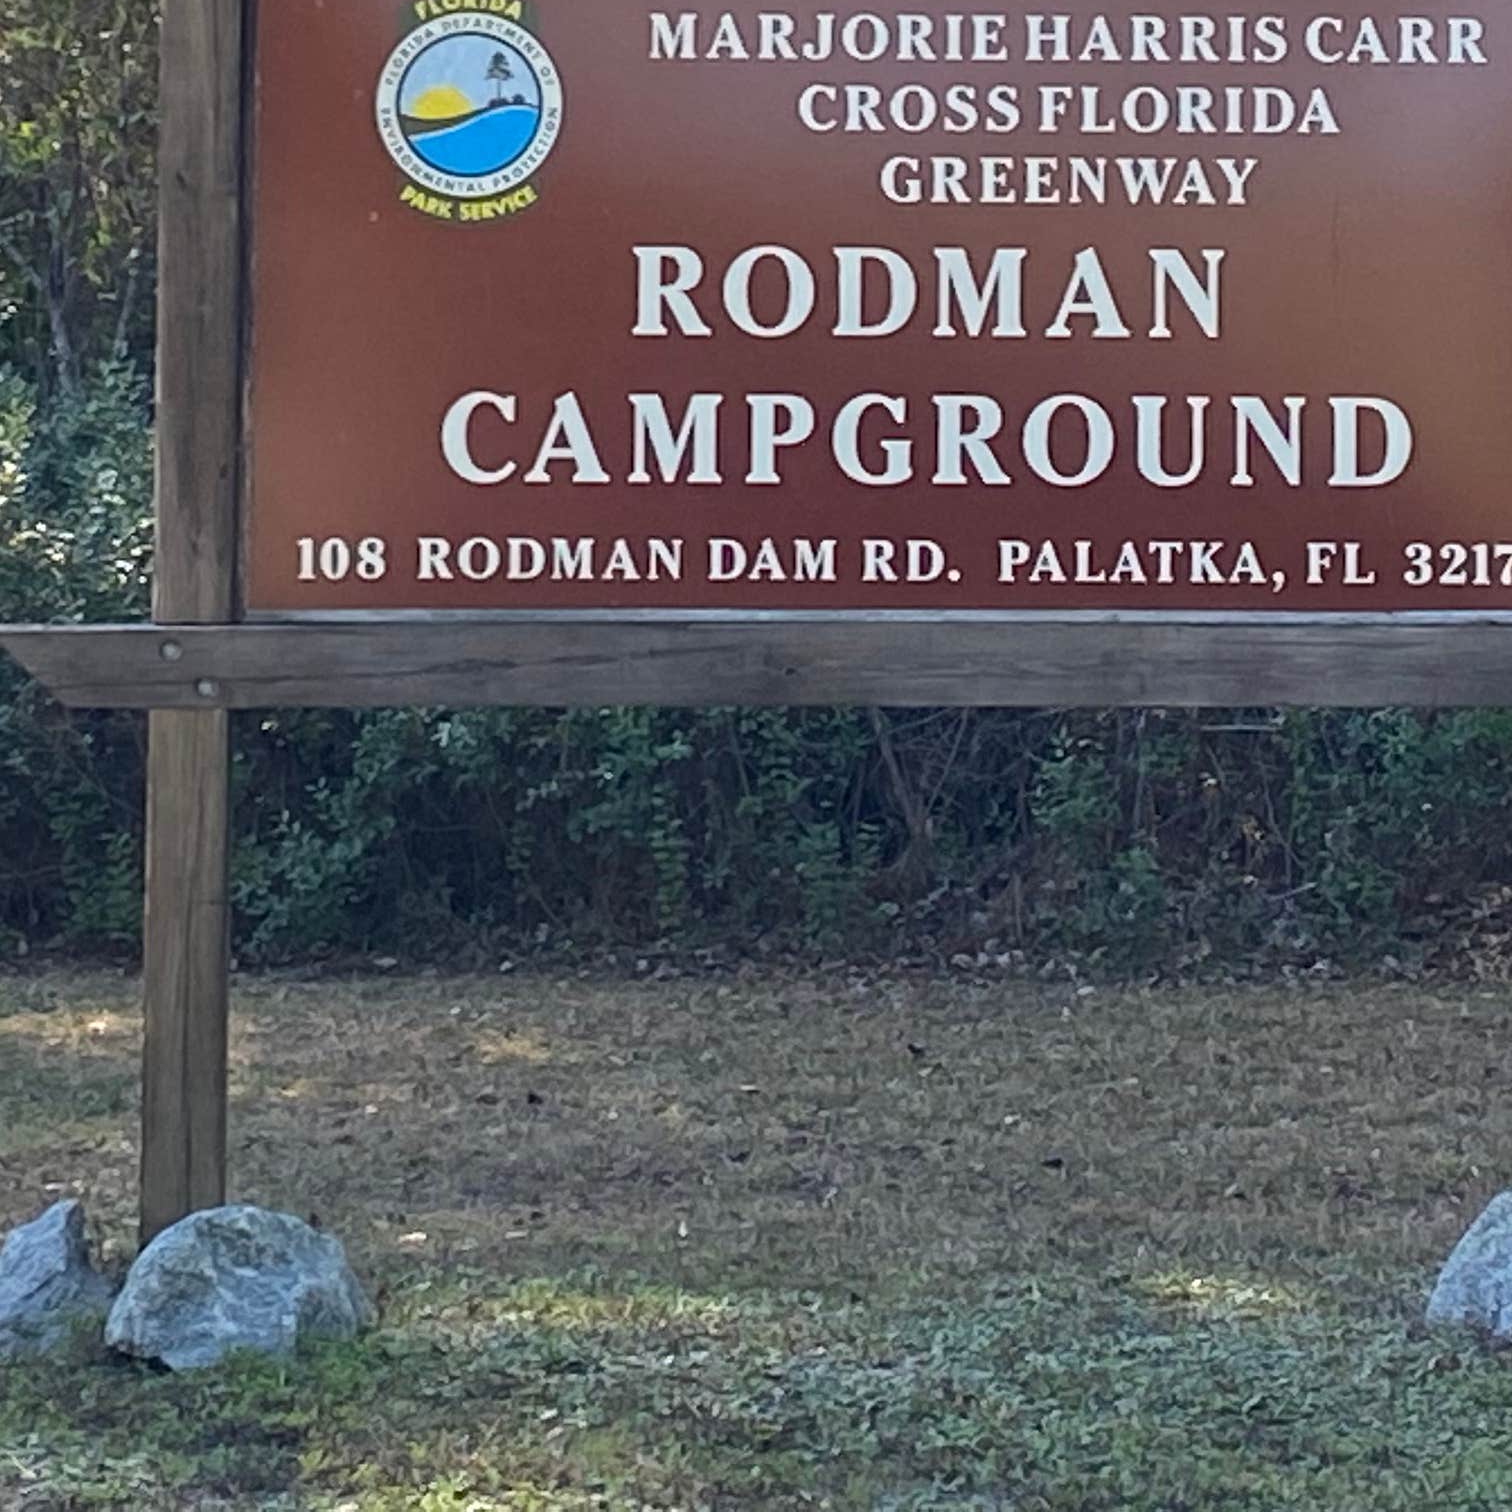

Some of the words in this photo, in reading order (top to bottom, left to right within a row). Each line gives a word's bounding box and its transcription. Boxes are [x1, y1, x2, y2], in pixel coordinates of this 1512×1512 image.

[385, 28, 435, 85] FLORIDA
[441, 16, 541, 60] DEPARTMENT
[540, 66, 556, 86] OF
[649, 12, 1008, 61] MARJORIE
[1025, 14, 1287, 63] HARRIS
[1304, 16, 1488, 64] CARR
[798, 84, 1020, 133] CROSS
[1038, 86, 1340, 134] FLORIDA
[381, 107, 486, 192] ENVIRONMENTAL
[492, 106, 559, 188] PROTECTION
[399, 186, 453, 219] PARK
[459, 185, 539, 221] SERVICE
[880, 156, 1258, 205] GREENWAY
[631, 245, 1225, 338] RODMAN
[441, 391, 1412, 487] CAMPGROUND
[297, 537, 386, 580] 108
[417, 536, 684, 581] RODMAN
[707, 537, 837, 581] DAM
[862, 539, 961, 582] RD.
[997, 539, 1286, 593] PALATKA,
[1306, 542, 1375, 584] FL
